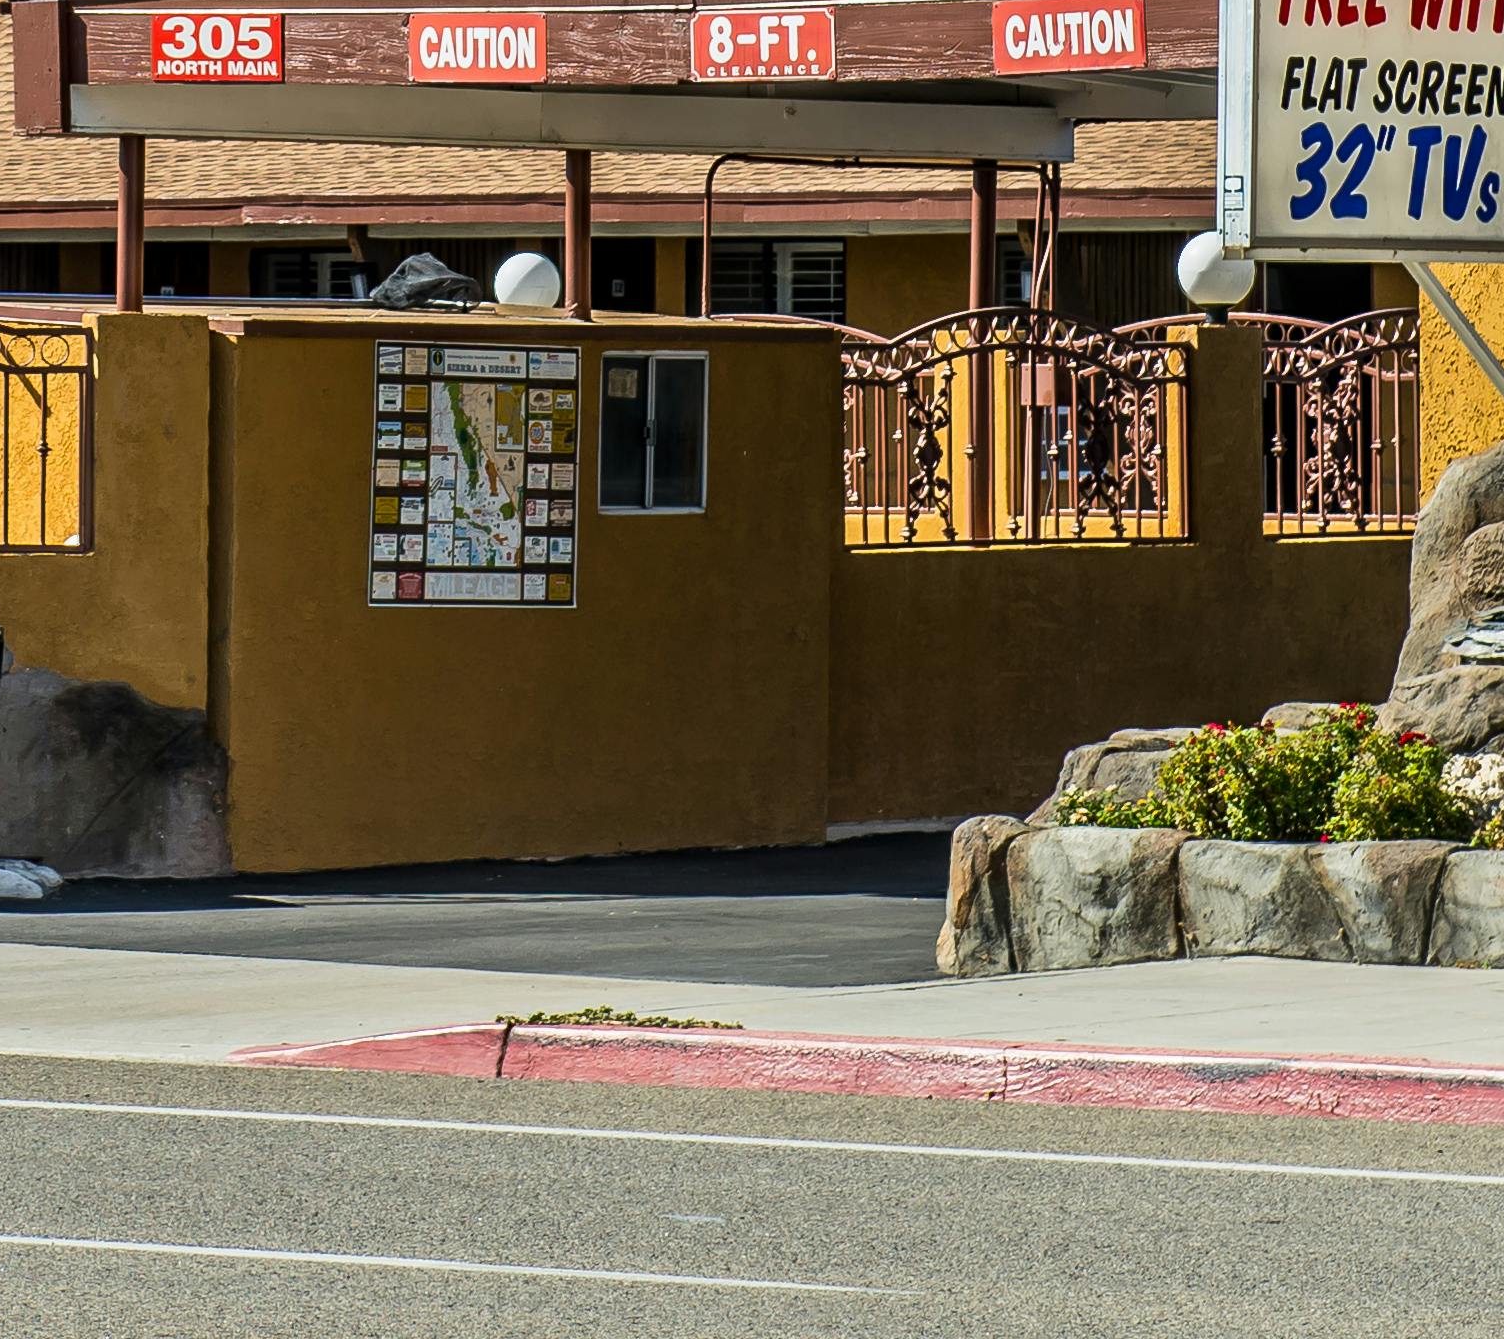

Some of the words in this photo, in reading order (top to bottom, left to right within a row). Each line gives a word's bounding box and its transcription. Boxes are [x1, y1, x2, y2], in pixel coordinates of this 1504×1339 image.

[160, 16, 274, 60] 305
[418, 25, 536, 70] CAUTION
[707, 15, 818, 64] 8-FT.
[1005, 8, 1136, 60] CAUTION
[156, 59, 219, 77] NORTH
[226, 59, 278, 77] MAIN
[706, 64, 821, 77] CLEARANCE
[1280, 55, 1368, 114] FLAT
[1289, 121, 1397, 220] 32"
[1407, 123, 1501, 223] TVs
[488, 365, 522, 375] DESERT
[428, 573, 517, 598] MILEAGE
